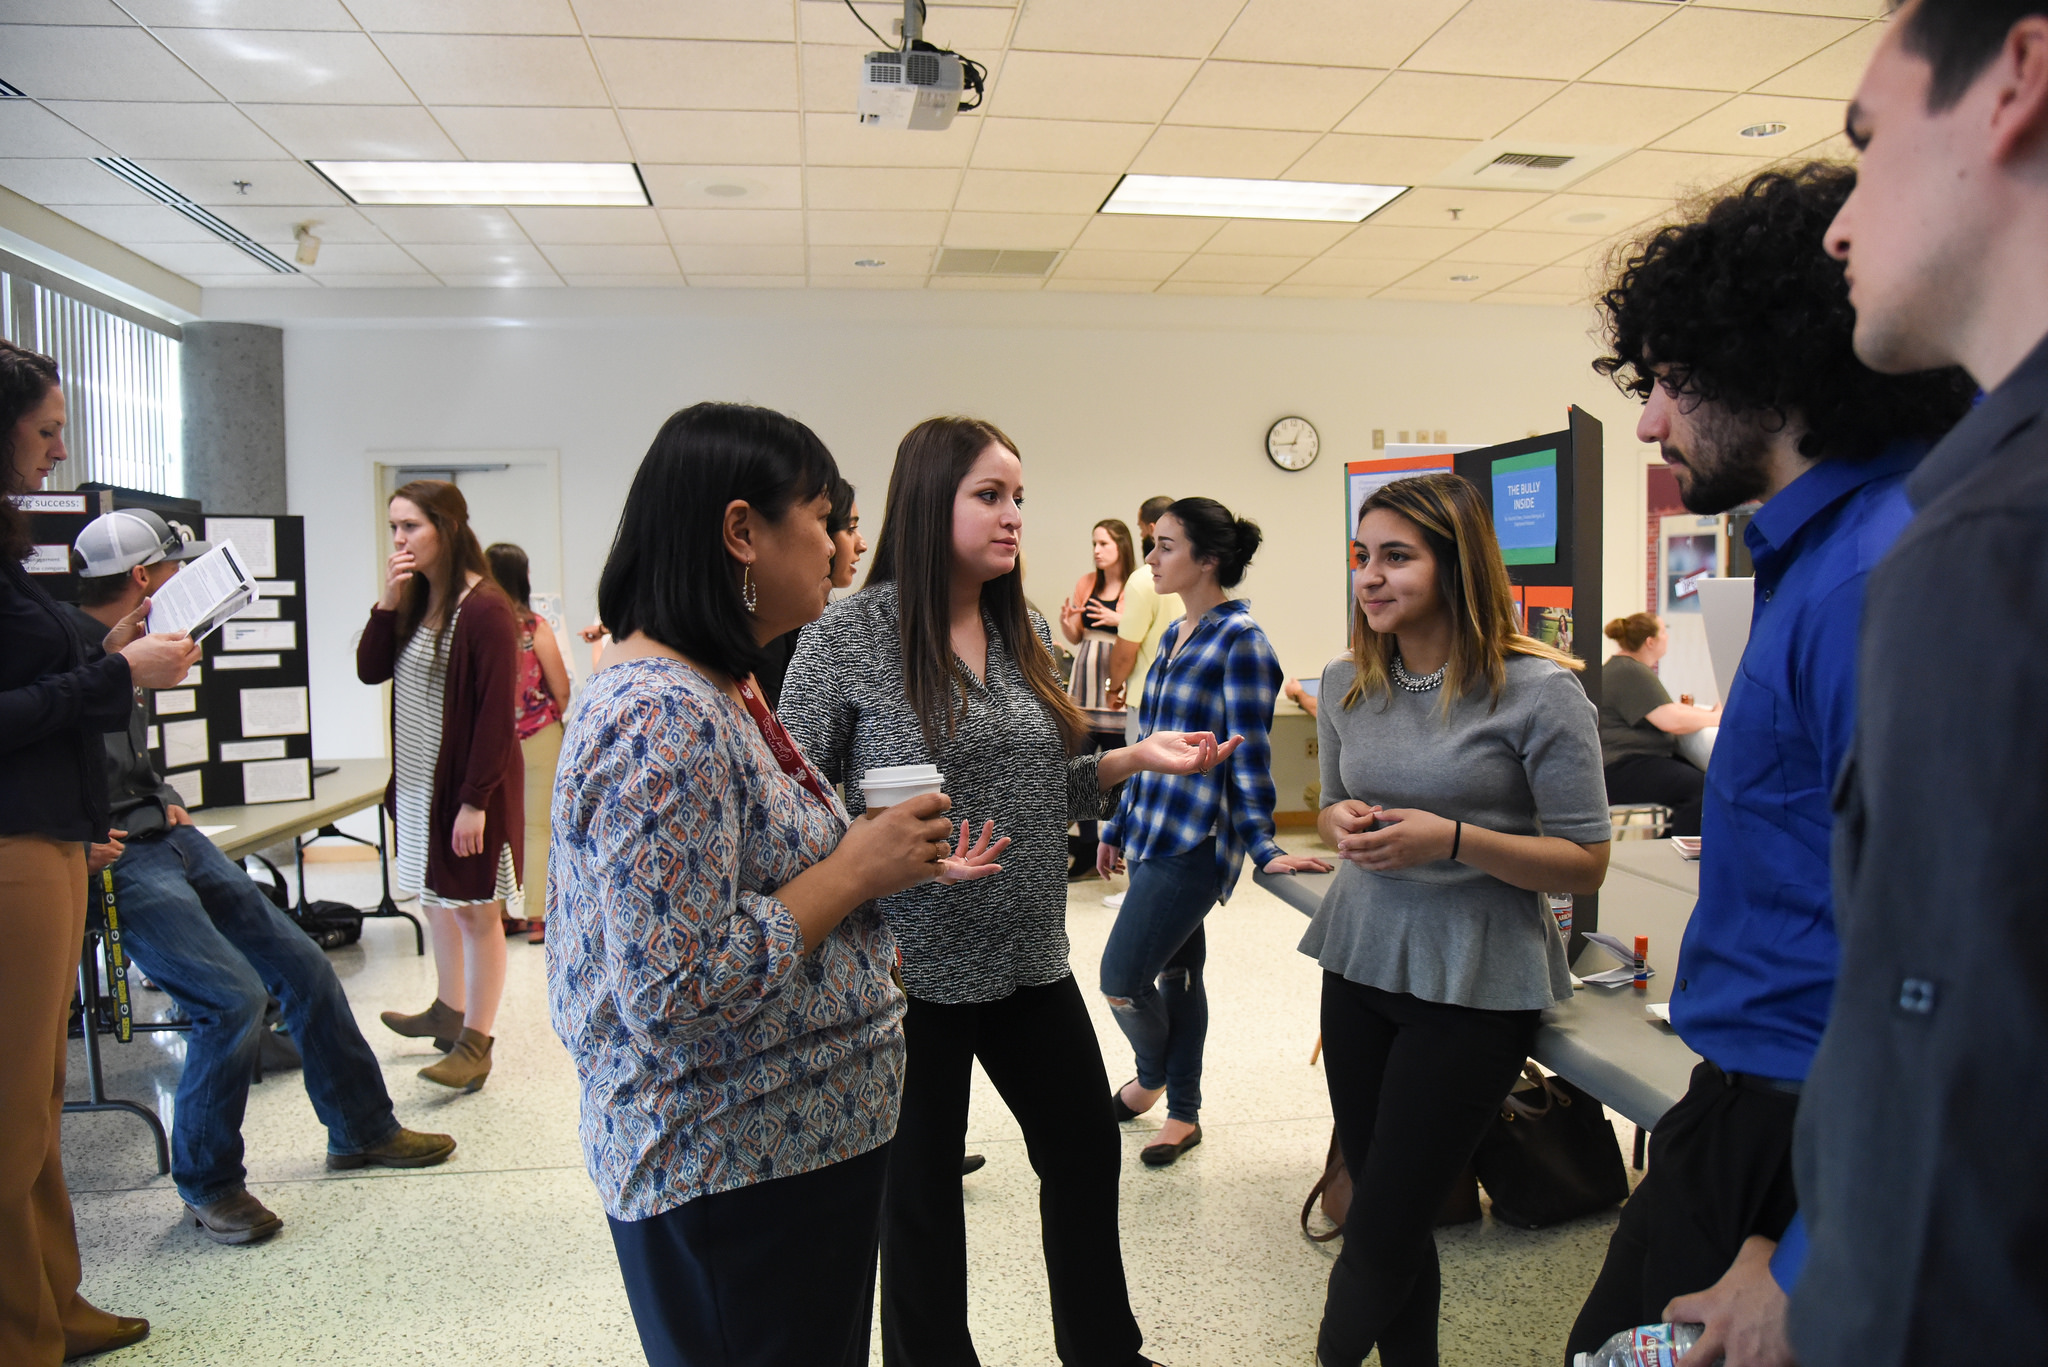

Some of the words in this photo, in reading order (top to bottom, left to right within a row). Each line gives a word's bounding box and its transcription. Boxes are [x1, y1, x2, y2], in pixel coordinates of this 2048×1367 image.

[1507, 484, 1520, 497] THE
[1520, 480, 1541, 495] BULLY
[35, 499, 80, 508] success:
[1513, 497, 1535, 510] INSIDE
